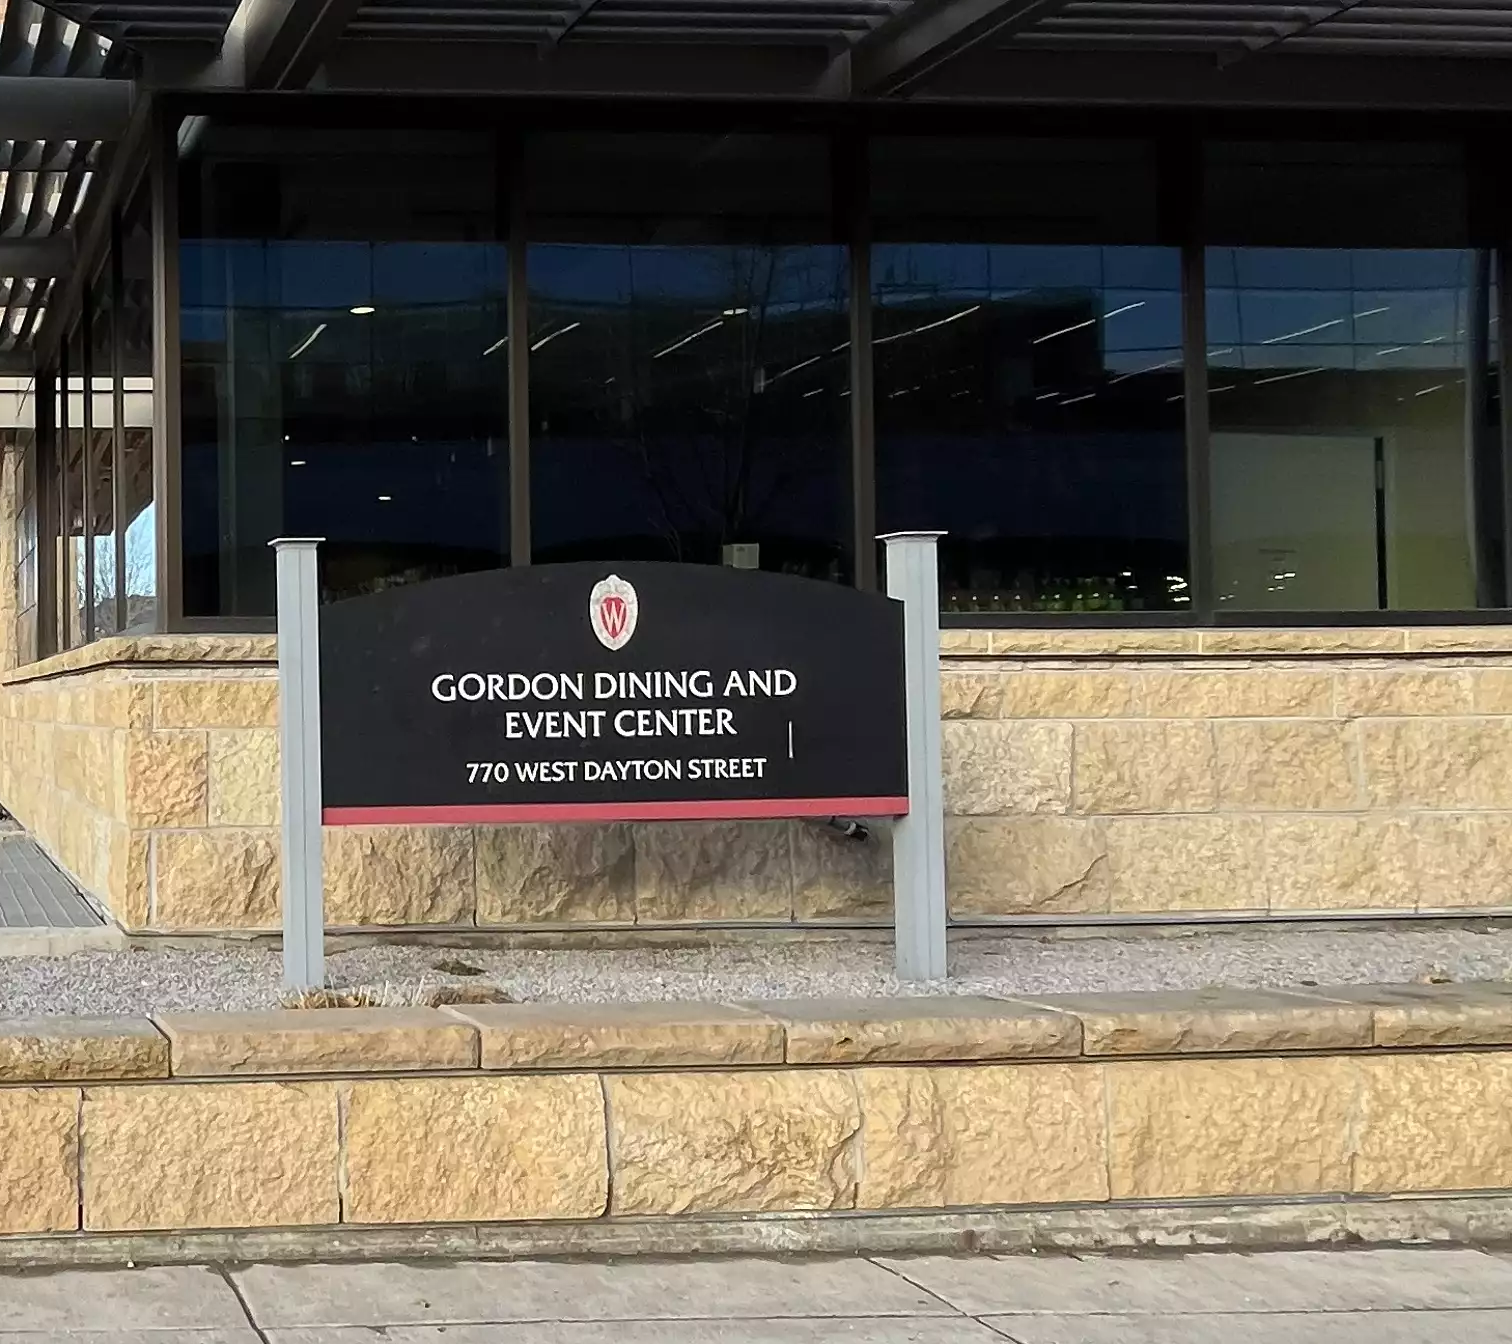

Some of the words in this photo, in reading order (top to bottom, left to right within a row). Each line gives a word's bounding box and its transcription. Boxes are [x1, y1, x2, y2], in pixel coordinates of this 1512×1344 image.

[601, 600, 625, 634] W
[431, 672, 584, 702] GORDON
[594, 670, 713, 699] DINING
[723, 669, 798, 697] AND
[505, 710, 606, 739] EVENT
[614, 708, 738, 738] CENTER
[466, 762, 509, 783] 770
[514, 761, 578, 783] WEST
[584, 759, 681, 782] DAYTON
[688, 758, 767, 779] STREET
